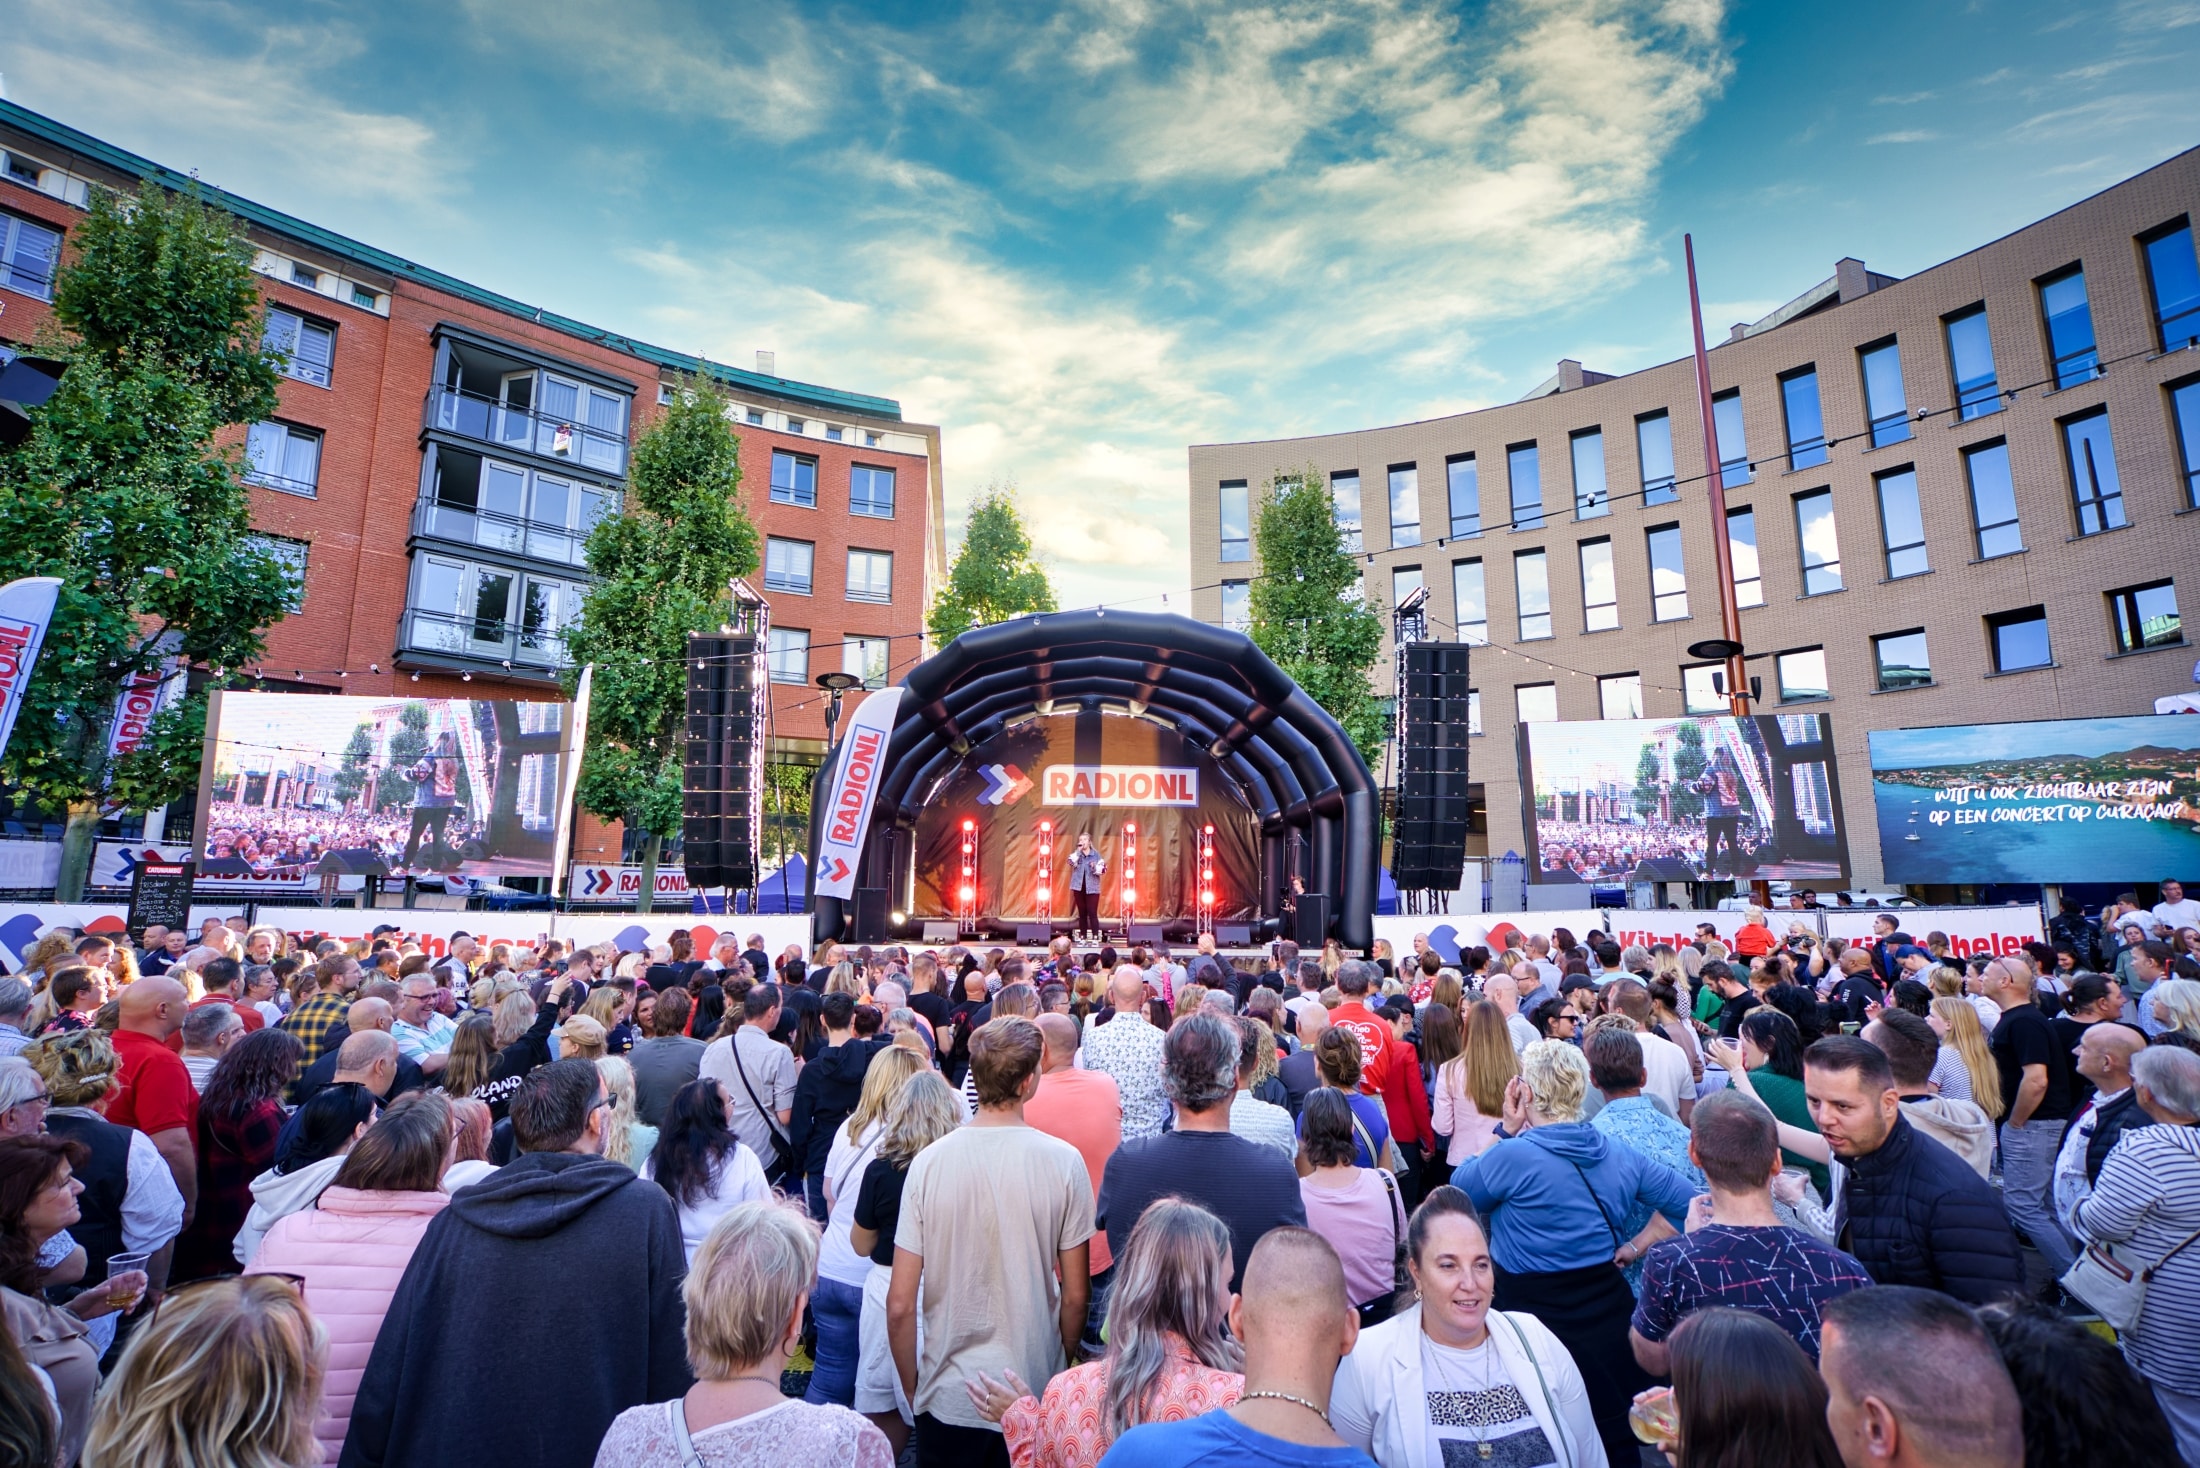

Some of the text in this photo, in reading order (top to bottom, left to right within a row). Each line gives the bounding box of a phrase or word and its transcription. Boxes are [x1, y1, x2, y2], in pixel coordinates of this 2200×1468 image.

[115, 669, 163, 754] ADIONL
[831, 733, 880, 842] RADIONL
[1050, 772, 1193, 800] RADIONL
[1934, 786, 1977, 805] WILT
[1990, 785, 2019, 800] OOK
[2023, 781, 2121, 799] ZICHTBAAR
[2126, 780, 2173, 796] ZIJN
[1929, 802, 2183, 826] OP EEN CONCERT OP CURAÇAO?
[620, 874, 687, 891] RAIONL
